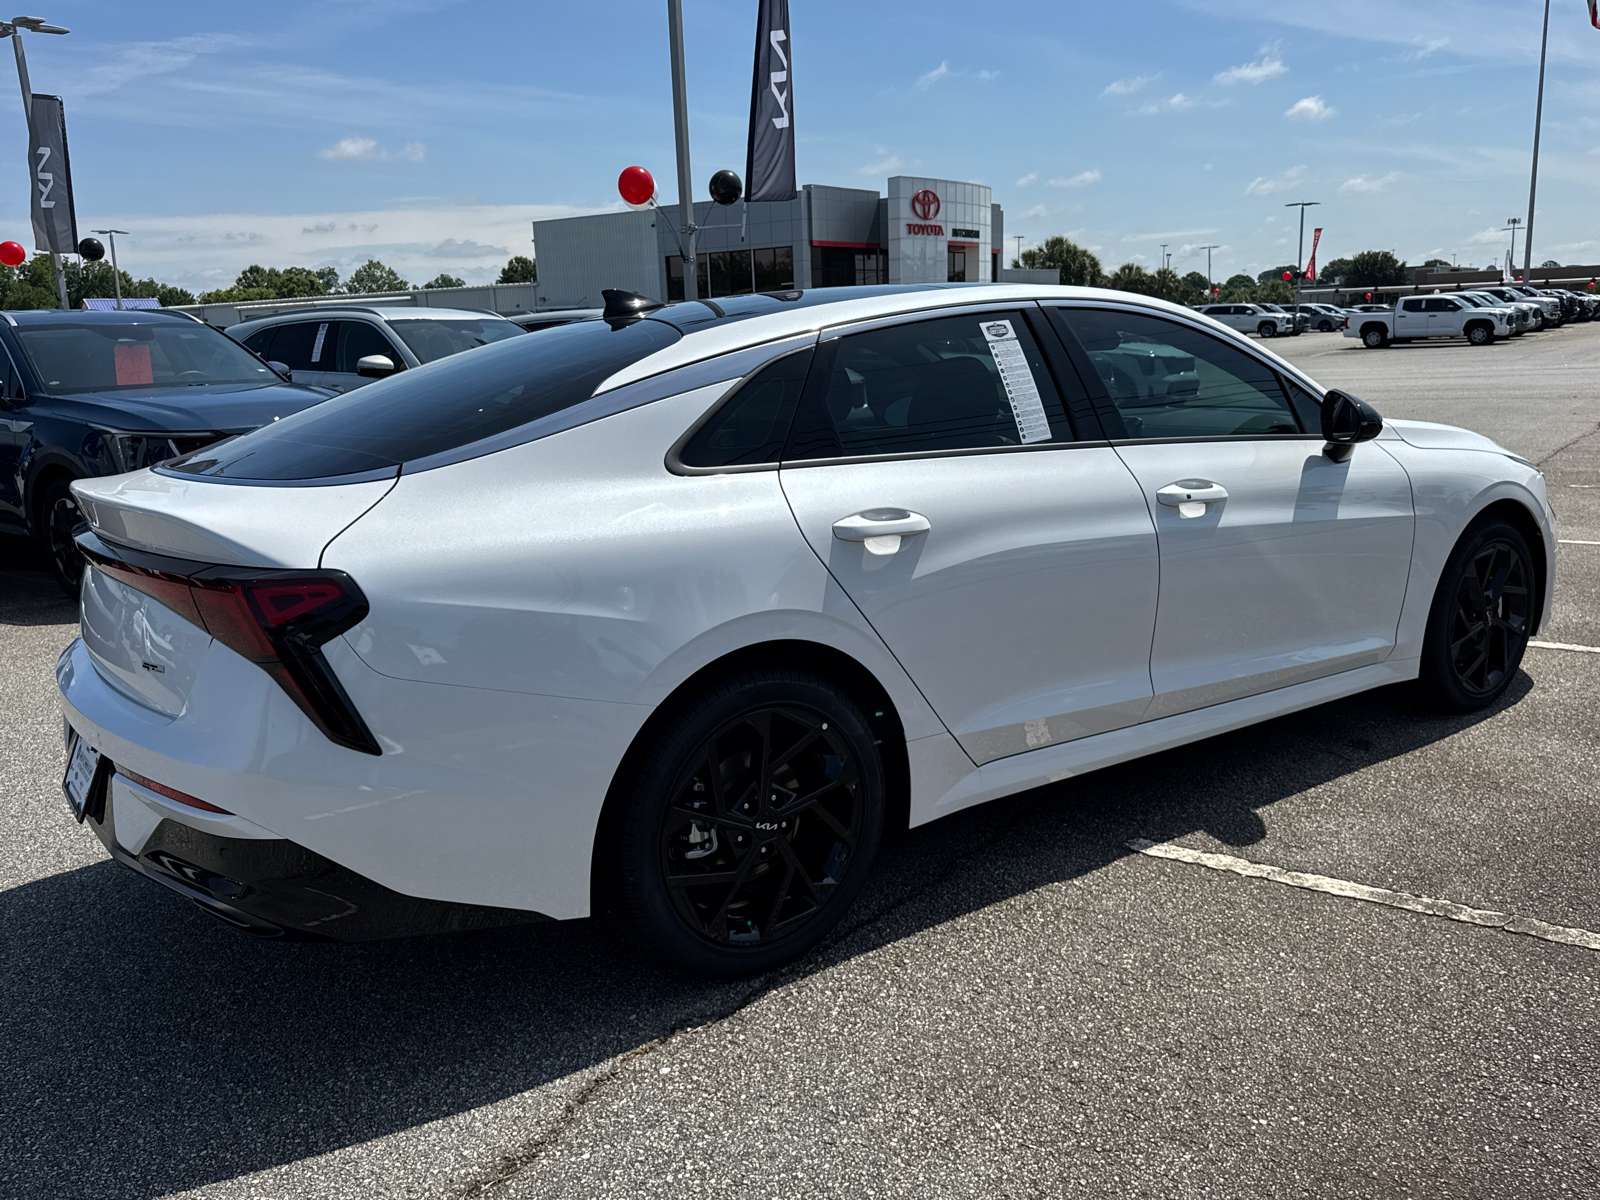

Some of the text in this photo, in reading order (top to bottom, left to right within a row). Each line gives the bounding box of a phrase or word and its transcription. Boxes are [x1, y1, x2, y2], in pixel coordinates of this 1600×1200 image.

[770, 29, 789, 129] KIA
[906, 223, 944, 236] TOYOTA
[121, 371, 143, 383] OFF
[755, 822, 778, 830] KIA
